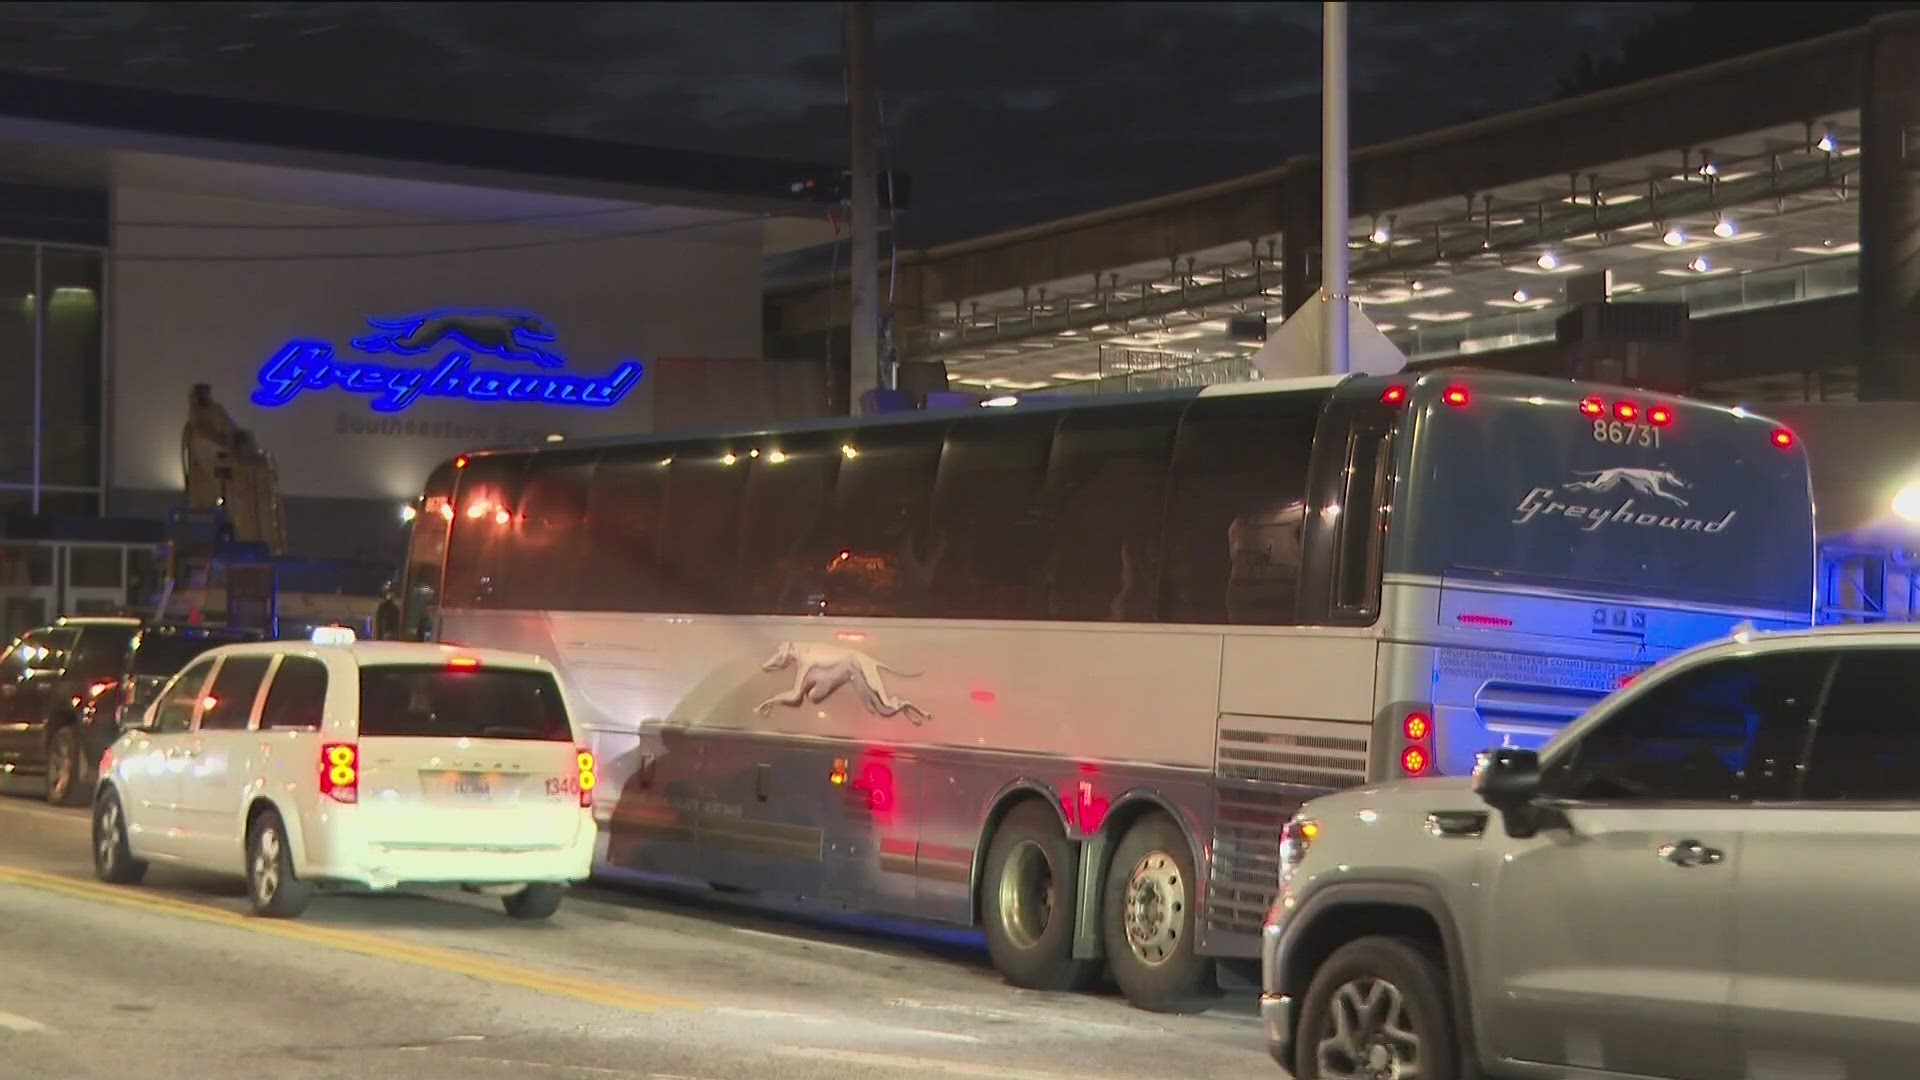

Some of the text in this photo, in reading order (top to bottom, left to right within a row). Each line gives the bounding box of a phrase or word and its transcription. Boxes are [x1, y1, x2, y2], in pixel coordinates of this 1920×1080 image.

[251, 340, 642, 412] Greyhound
[1592, 418, 1661, 448] 86731
[1511, 487, 1737, 533] Greyhound
[544, 776, 579, 796] 1340
